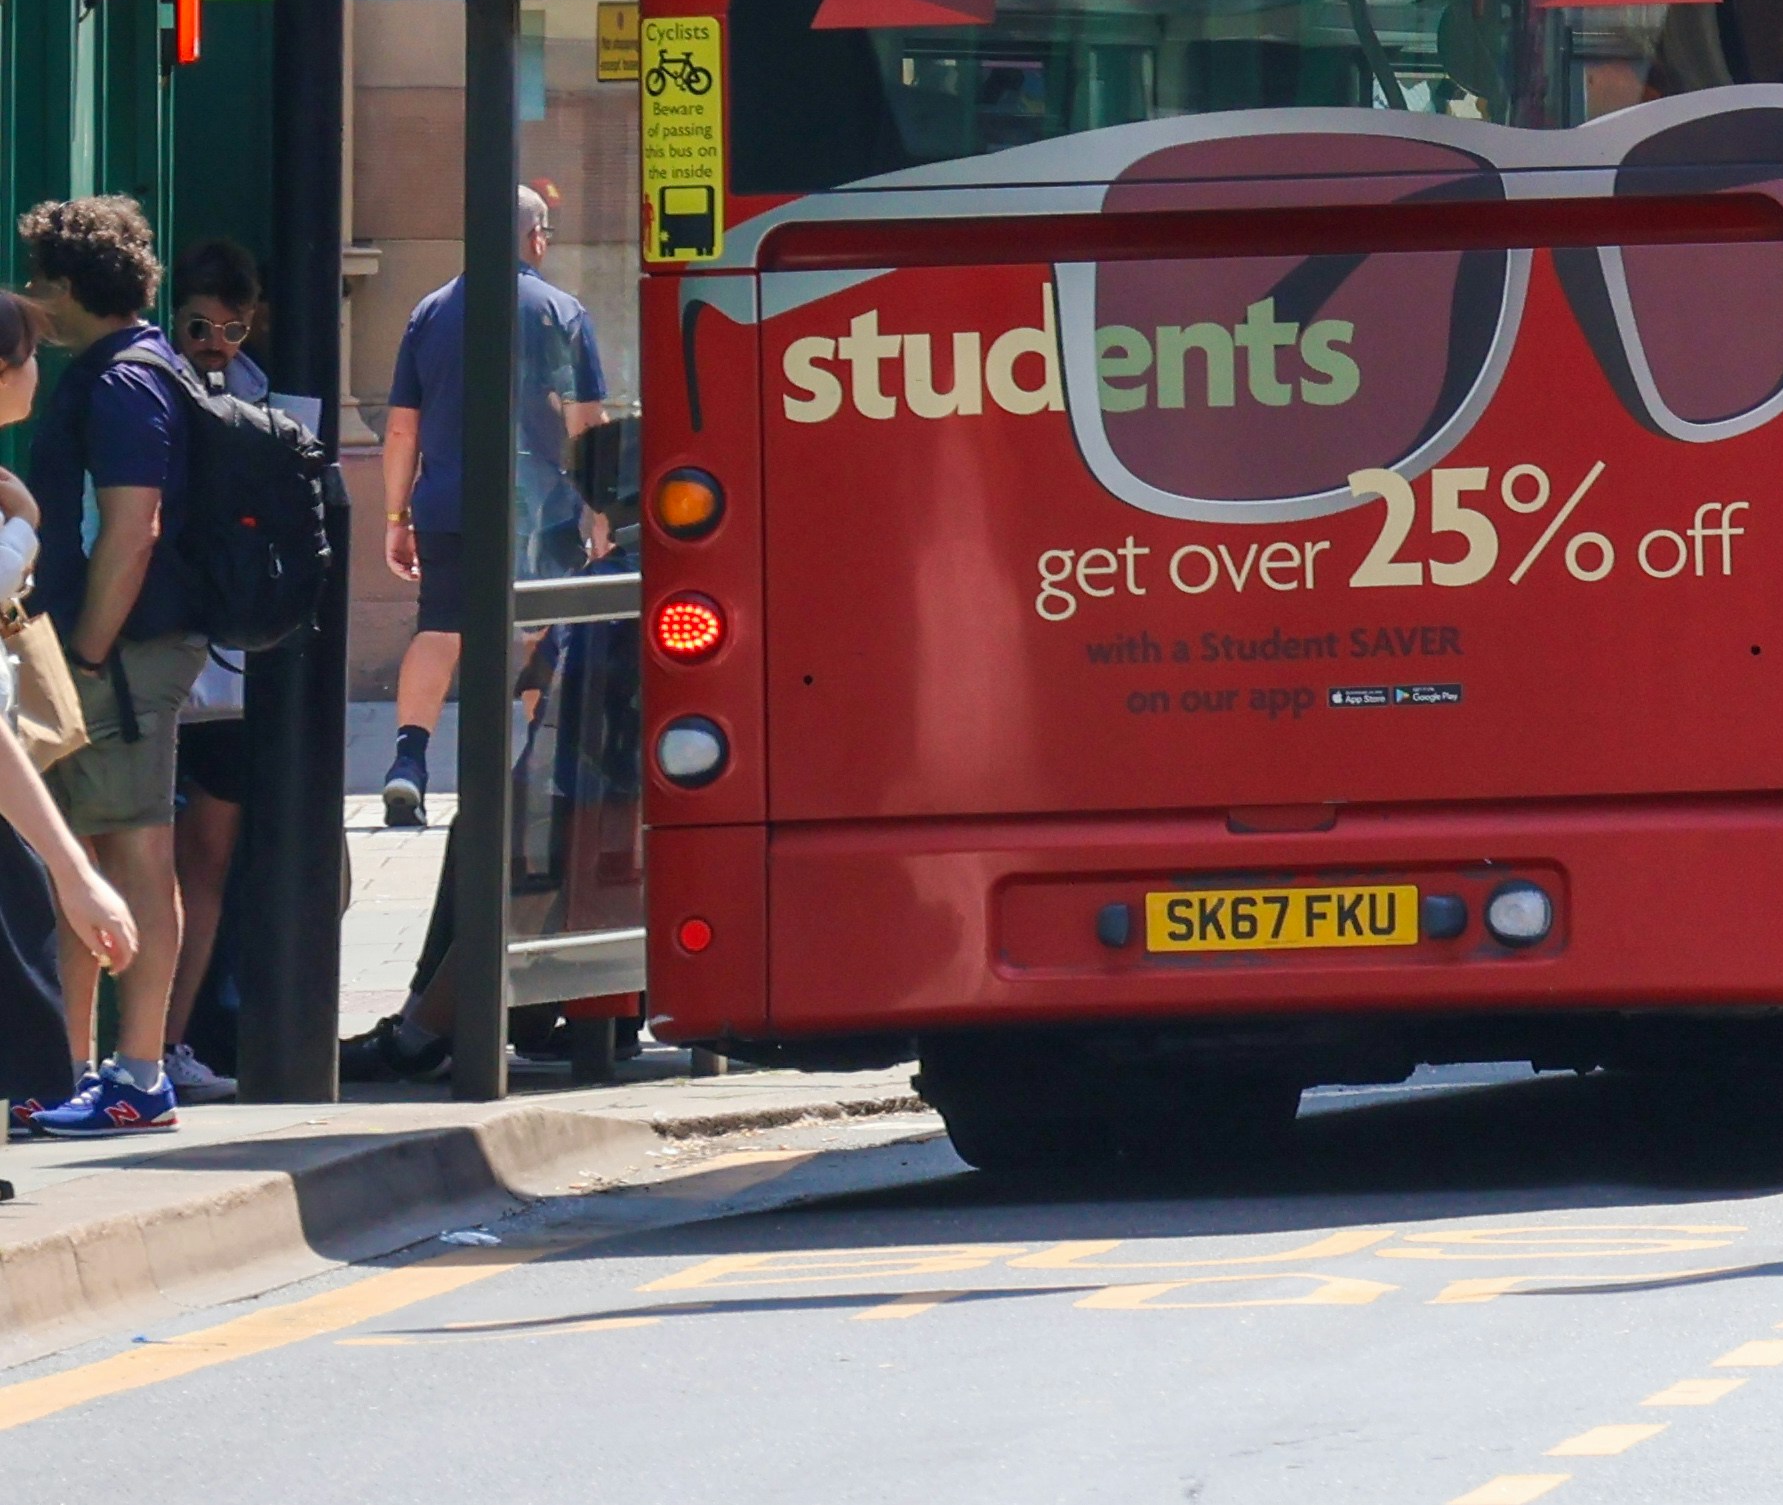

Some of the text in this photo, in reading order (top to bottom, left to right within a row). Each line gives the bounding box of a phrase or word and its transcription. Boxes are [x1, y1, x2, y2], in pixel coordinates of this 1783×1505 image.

[646, 23, 711, 47] Cyclists
[652, 102, 704, 116] Beware
[647, 122, 713, 140] of passing
[646, 144, 717, 158] this bus on
[648, 163, 713, 180] the inside
[782, 282, 1361, 424] students
[1035, 459, 1750, 622] get over 25% off
[1085, 625, 1465, 665] with a Student SAVER
[1127, 685, 1315, 720] on our app
[1345, 692, 1458, 704] App Store Google Play
[1167, 892, 1396, 942] SK67 FKU
